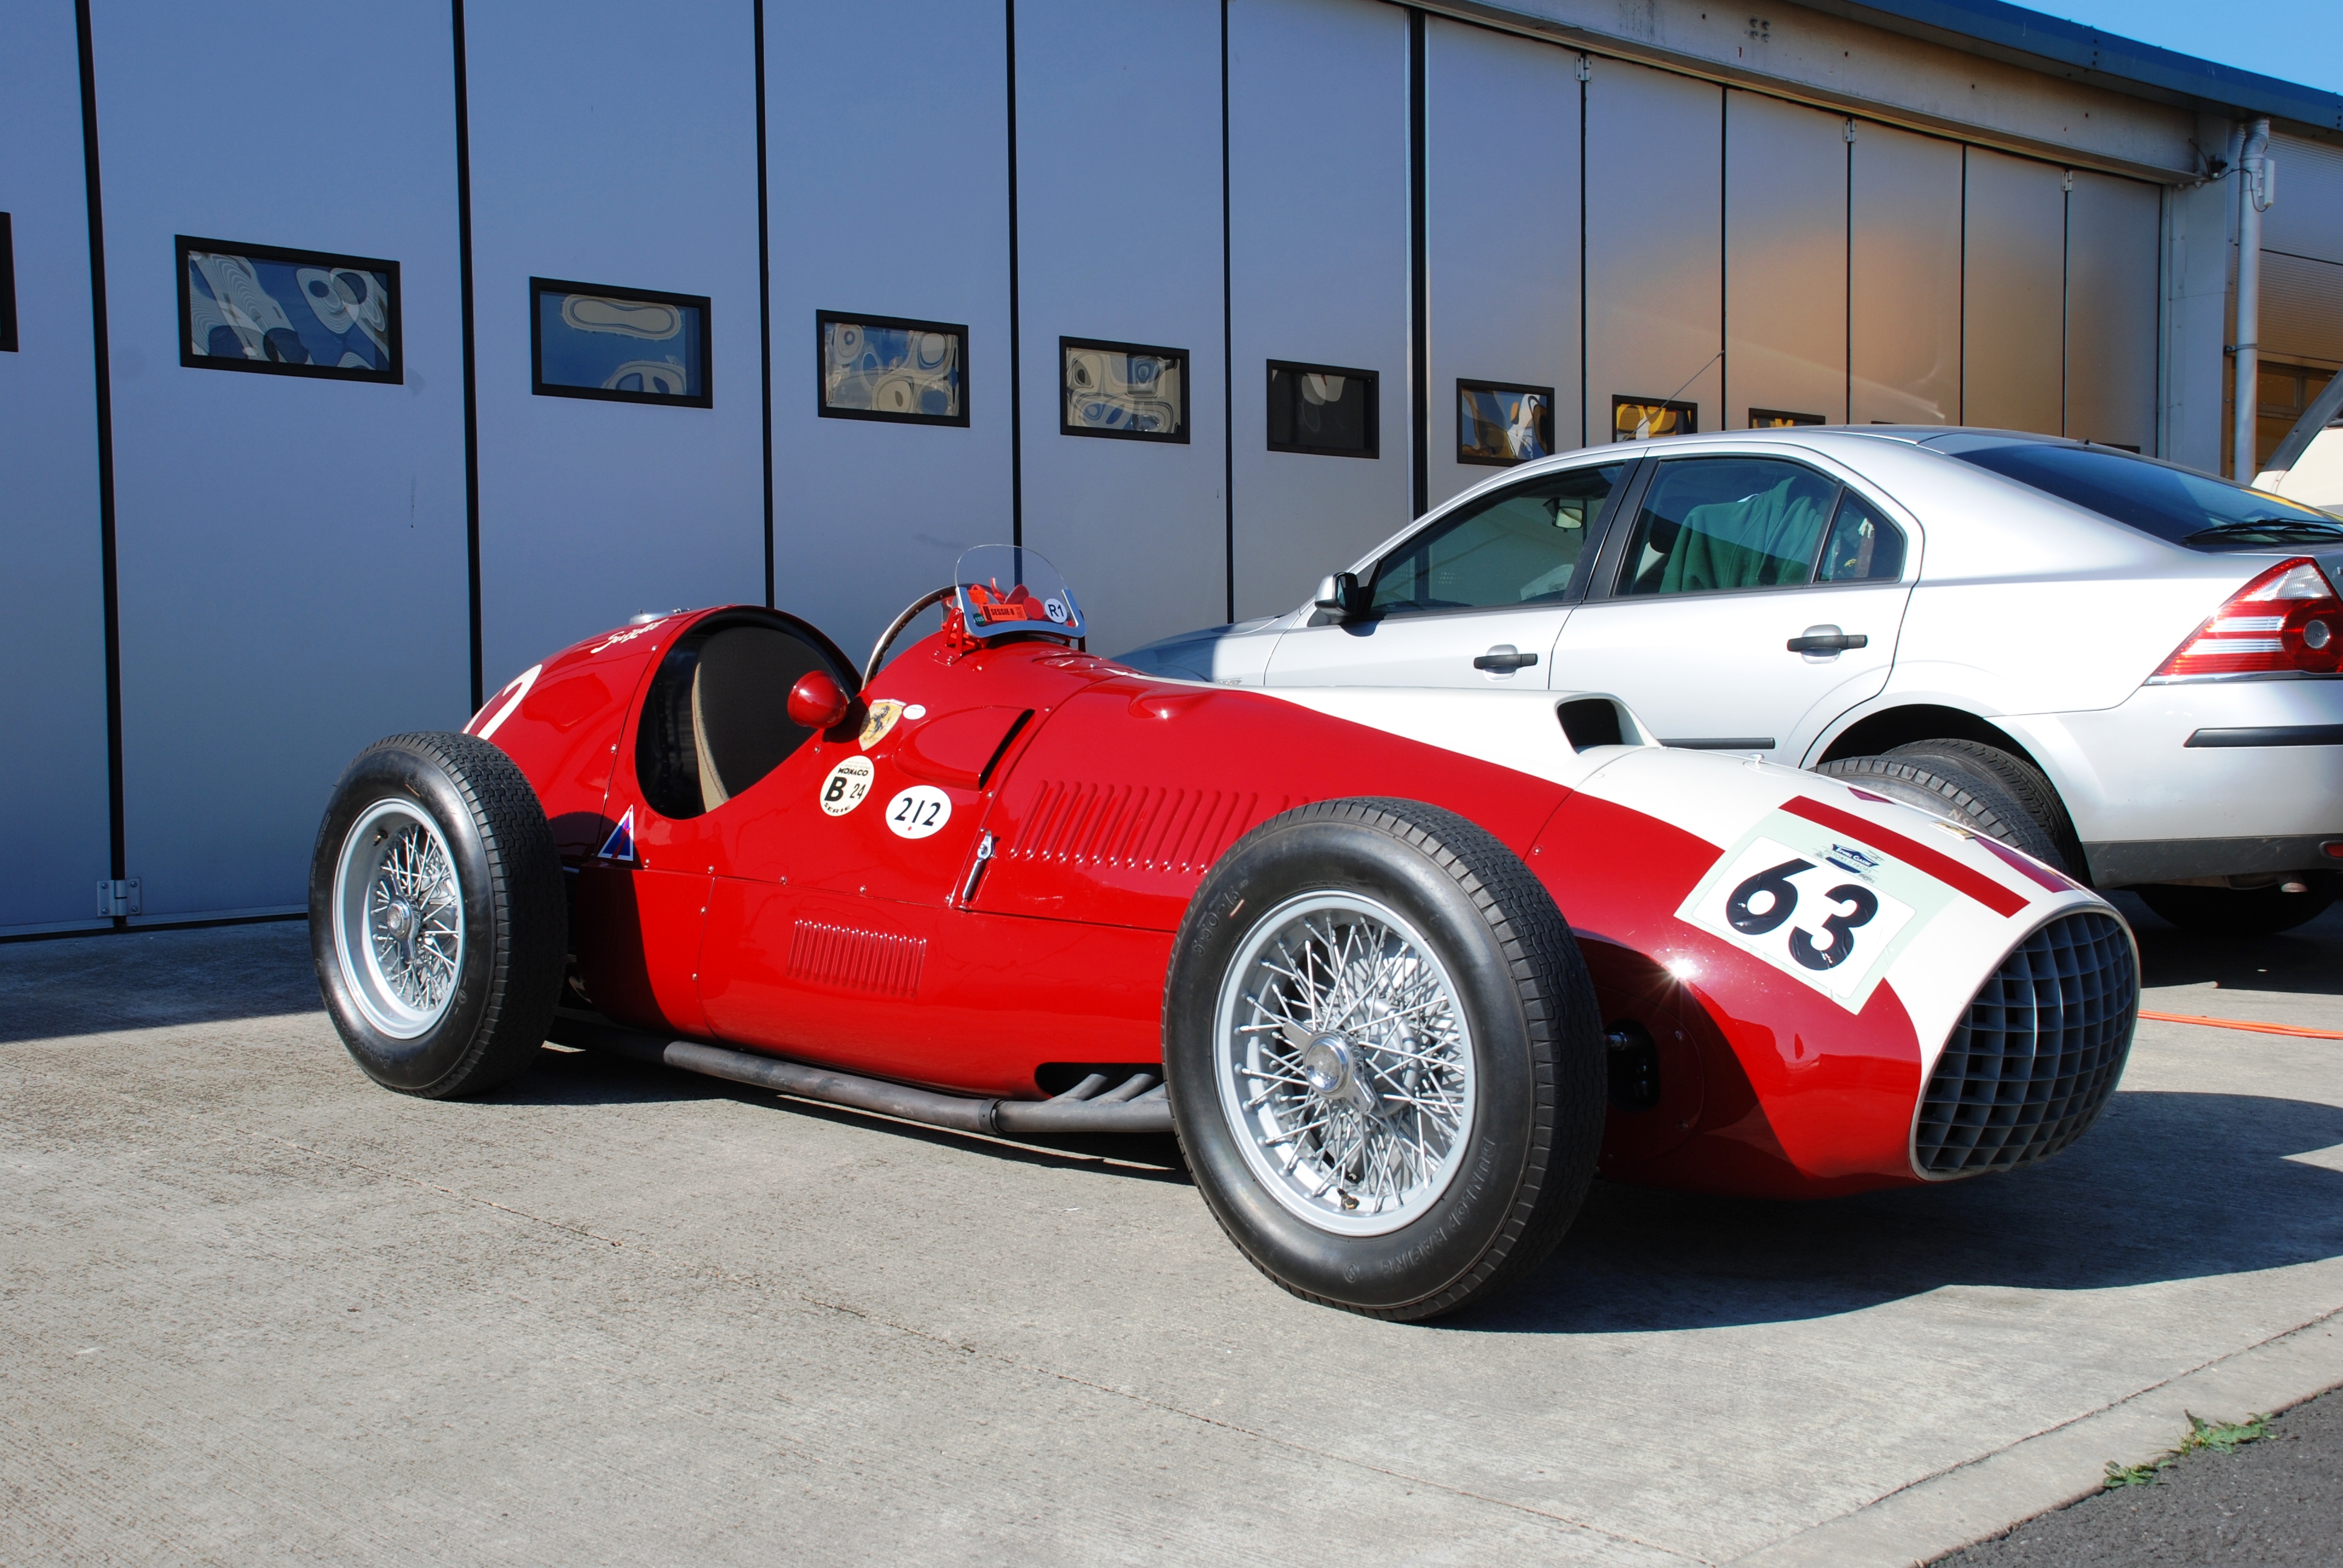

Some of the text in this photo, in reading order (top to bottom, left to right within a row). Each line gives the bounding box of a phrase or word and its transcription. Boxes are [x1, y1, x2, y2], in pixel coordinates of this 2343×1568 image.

[1047, 604, 1064, 618] R1
[837, 767, 869, 777] MONACO
[824, 776, 848, 802] B
[849, 783, 867, 800] 24
[894, 797, 942, 827] 212
[1824, 849, 1847, 861] PISTONS
[1853, 862, 1873, 874] PROPS
[1726, 858, 1878, 971] 63
[1381, 1135, 1496, 1278] DUNLOP RACING
